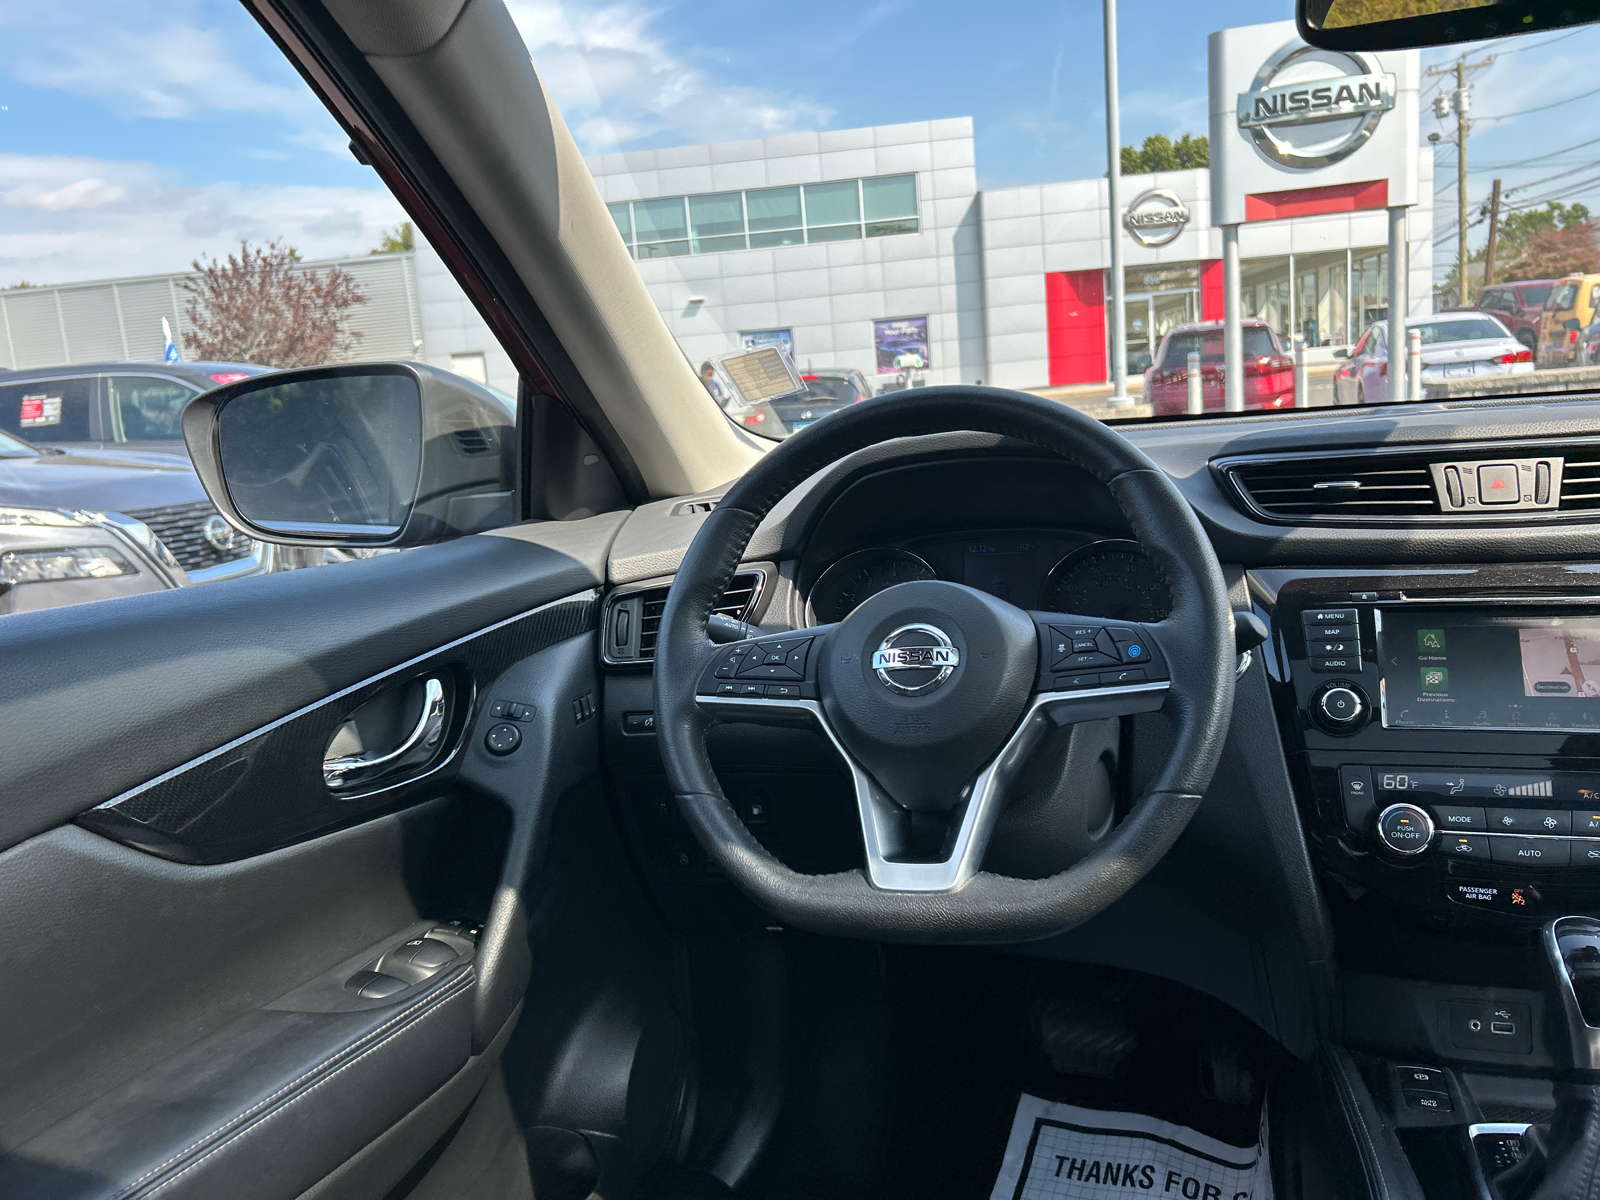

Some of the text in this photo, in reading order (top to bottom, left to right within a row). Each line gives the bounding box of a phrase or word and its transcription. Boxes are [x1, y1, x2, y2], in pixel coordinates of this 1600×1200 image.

[1253, 82, 1381, 119] NISSAN
[1129, 210, 1186, 226] NISSAN
[724, 622, 739, 630] AUTO
[879, 650, 949, 665] NISSAN
[1325, 682, 1352, 690] VOLUME
[1448, 815, 1472, 823] MODE
[1390, 831, 1421, 840] ON-OFF
[1517, 850, 1542, 858] AUTO
[1458, 886, 1498, 895] PASSENGER
[1478, 893, 1492, 901] BAG
[1054, 1155, 1222, 1200] THANKS FOR
